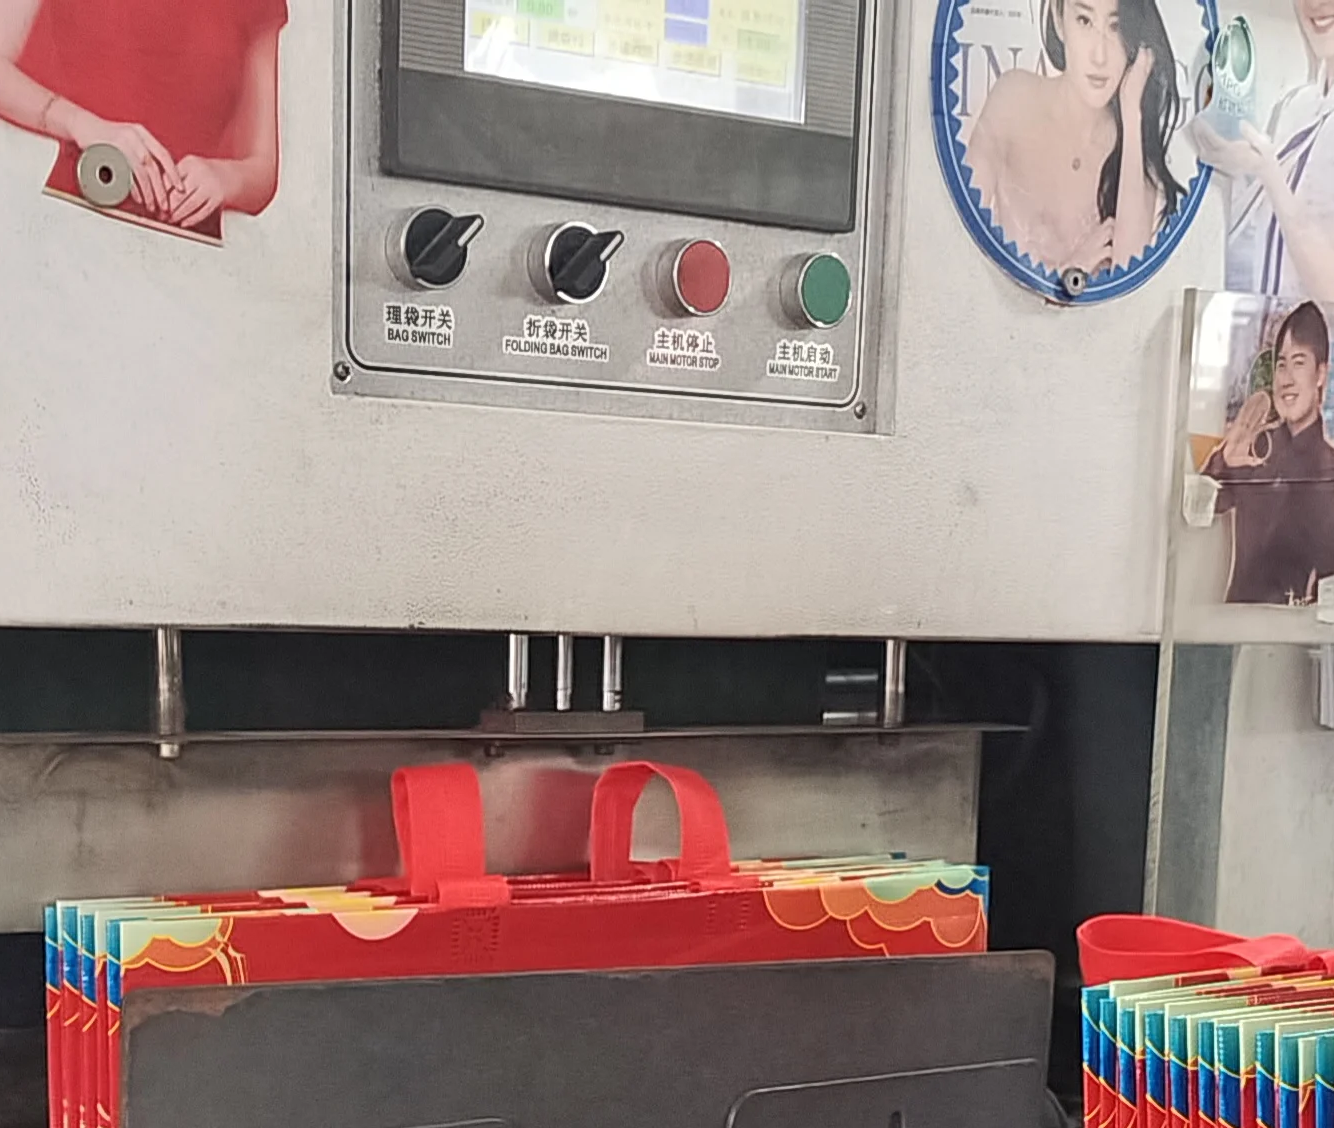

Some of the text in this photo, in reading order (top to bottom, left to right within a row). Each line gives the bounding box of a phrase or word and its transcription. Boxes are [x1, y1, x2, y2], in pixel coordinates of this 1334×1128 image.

[386, 305, 453, 330] 理袋开关
[387, 328, 451, 346] BAG SWITCH
[526, 318, 588, 342] 折袋开关
[505, 338, 608, 359] FOLDING BAG SWITCH
[655, 330, 714, 353] 主机停止
[649, 351, 720, 369] MAIN MOTOR STOP
[777, 342, 831, 364] 主机启动
[769, 362, 838, 380] MAIN MOTOR START
